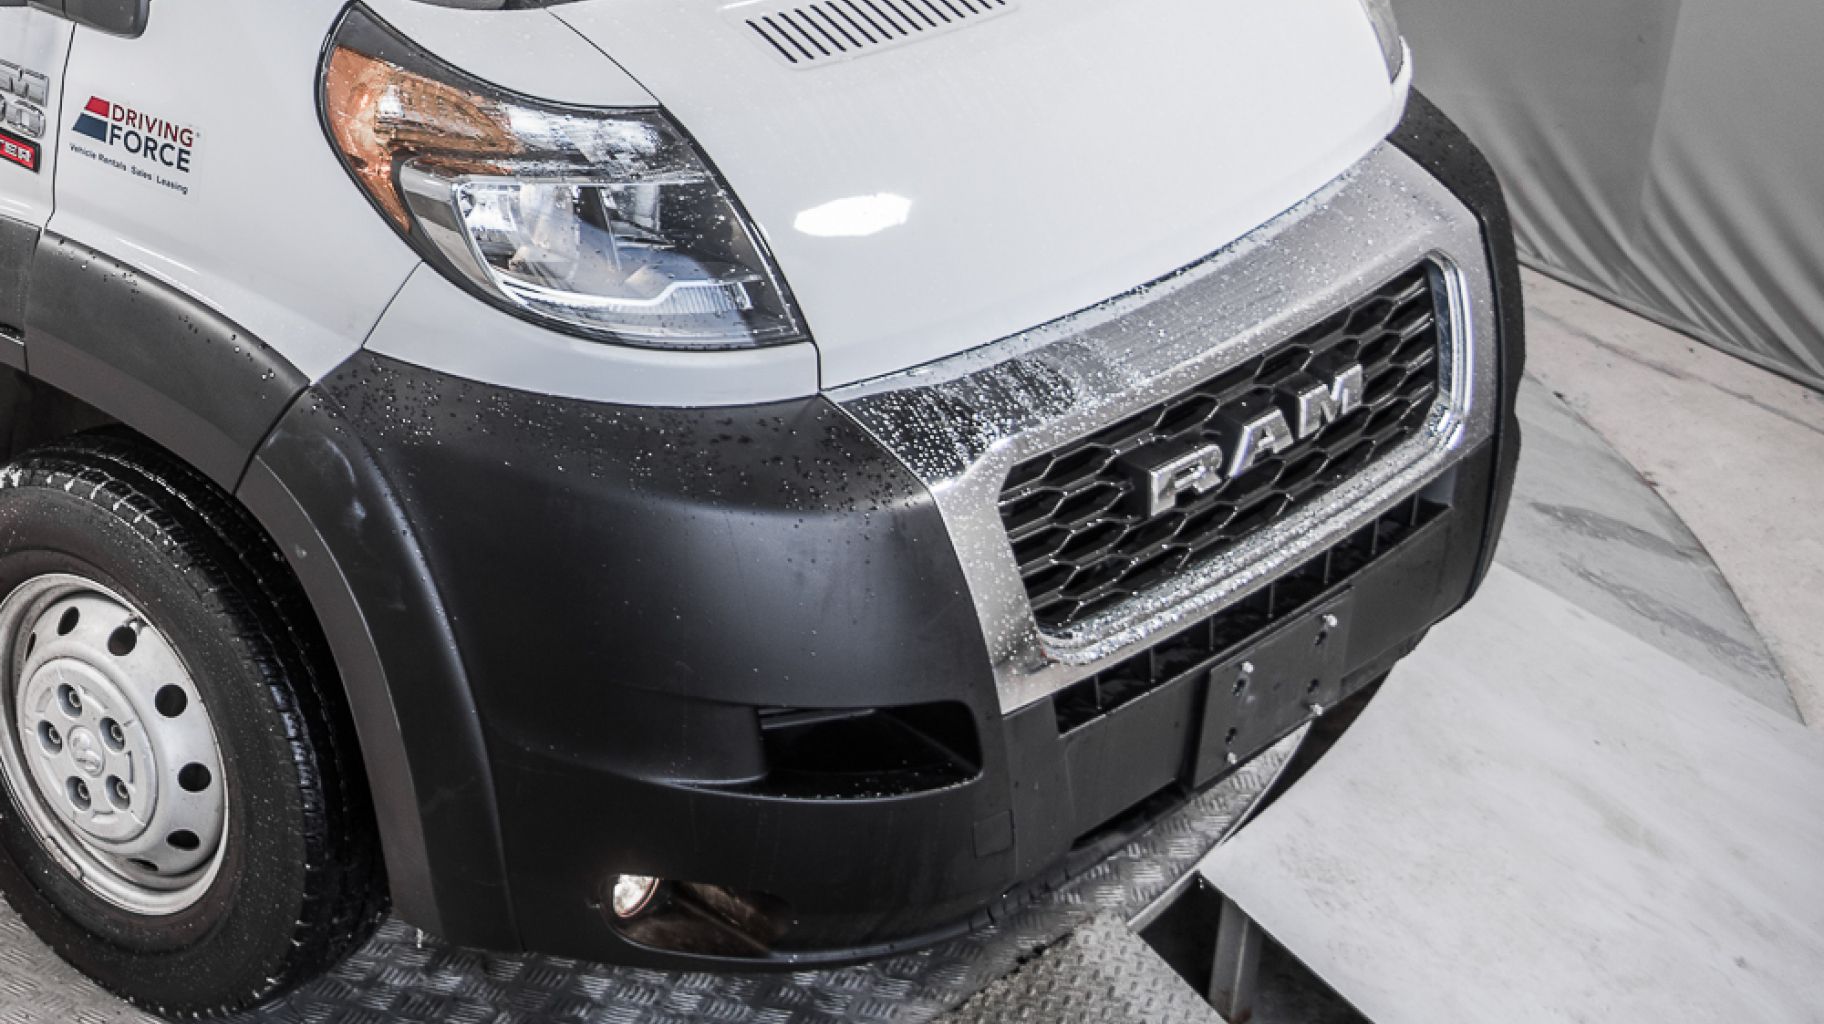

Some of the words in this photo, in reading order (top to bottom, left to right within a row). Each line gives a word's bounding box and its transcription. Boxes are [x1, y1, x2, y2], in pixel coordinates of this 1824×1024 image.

[109, 122, 192, 174] FORCE
[111, 103, 194, 147] DRIVING
[69, 142, 97, 160] Vehicle
[97, 153, 127, 172] Rentals
[130, 164, 153, 181] Sales
[156, 175, 189, 195] Leasing
[1148, 363, 1364, 518] RAM
